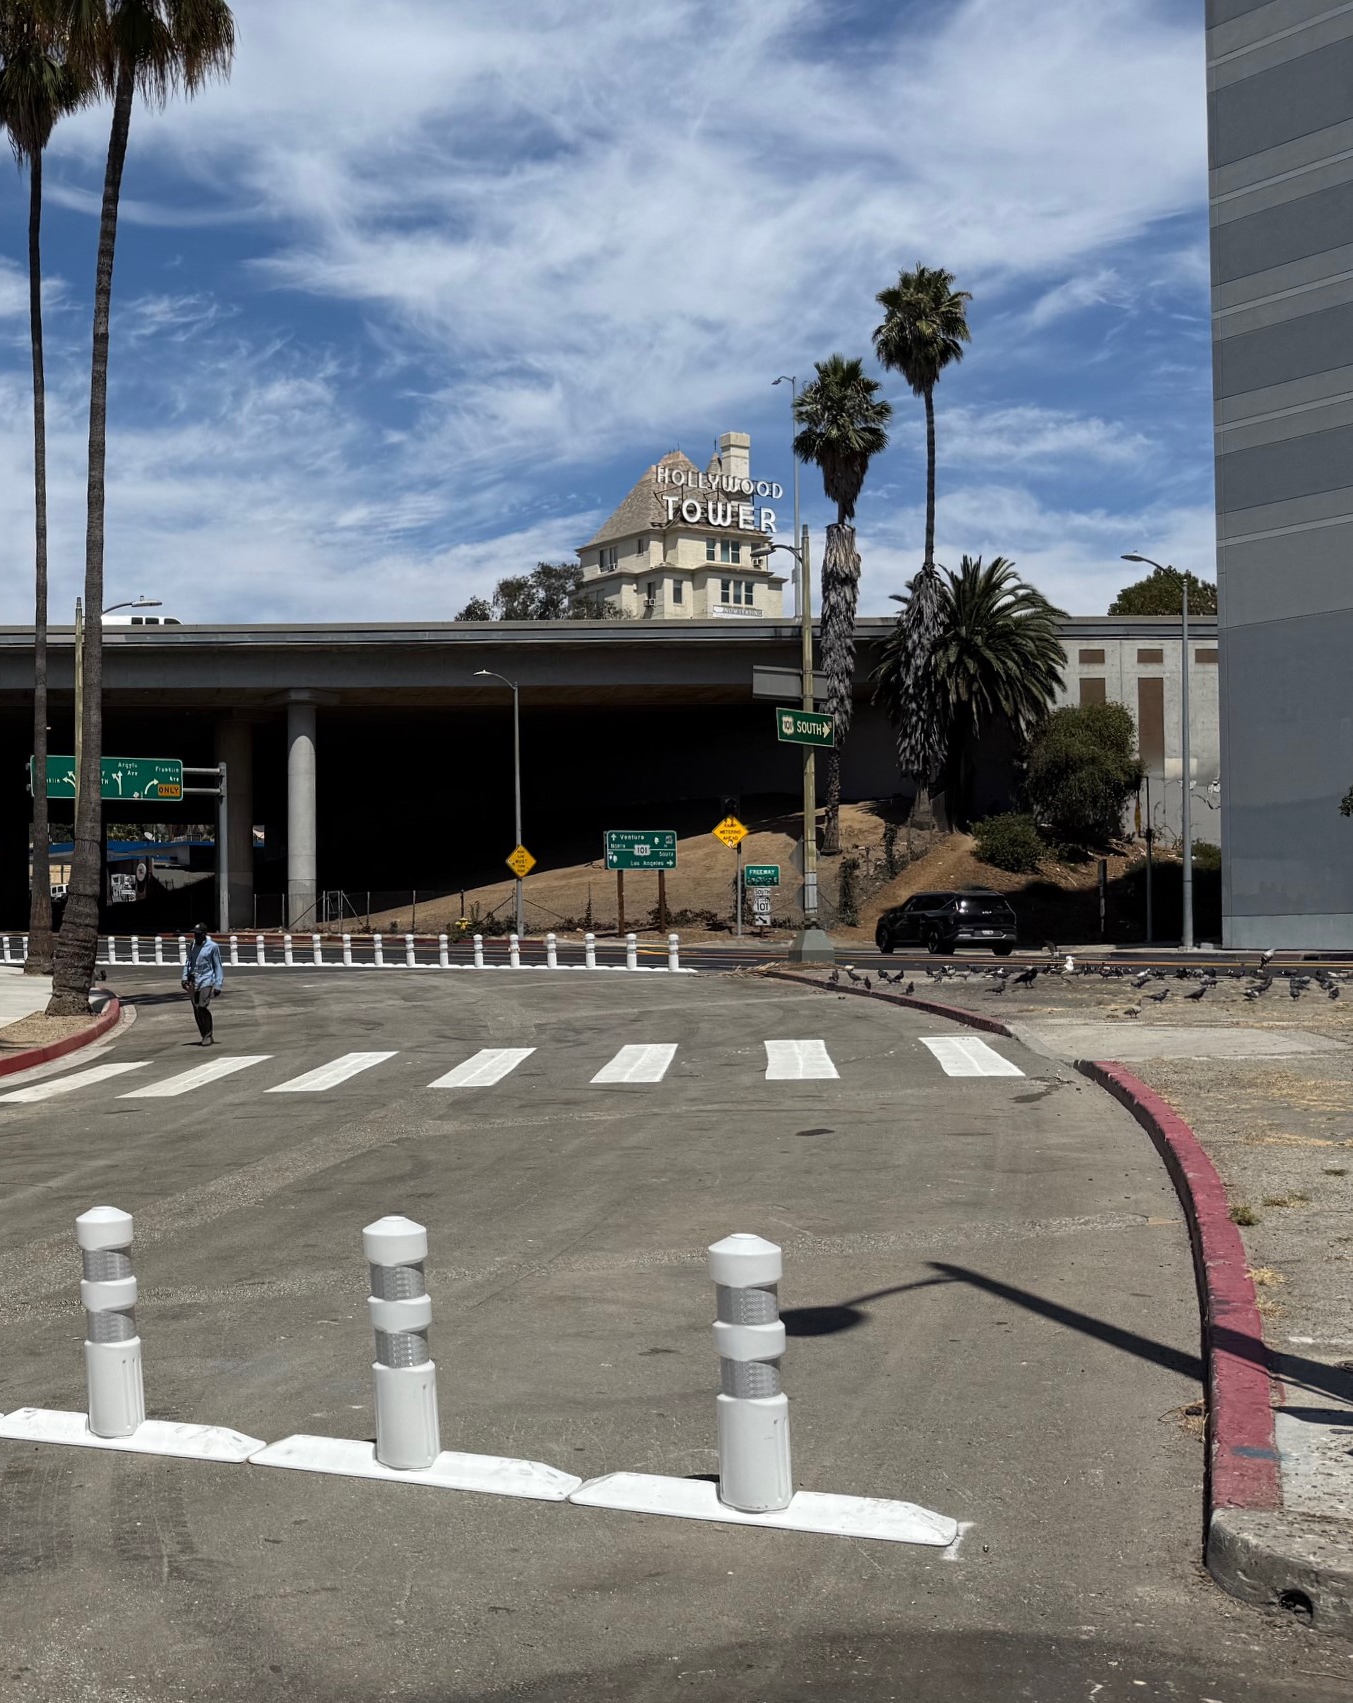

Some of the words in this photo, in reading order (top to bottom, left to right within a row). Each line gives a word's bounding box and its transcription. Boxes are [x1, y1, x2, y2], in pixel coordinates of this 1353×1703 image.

[656, 465, 783, 499] HOLLYWOOD
[661, 494, 777, 533] TOWER
[796, 720, 822, 736] SOUTH
[158, 786, 179, 795] ONLY
[636, 846, 648, 854] 101
[642, 860, 664, 868] Angeles
[756, 902, 768, 911] 101
